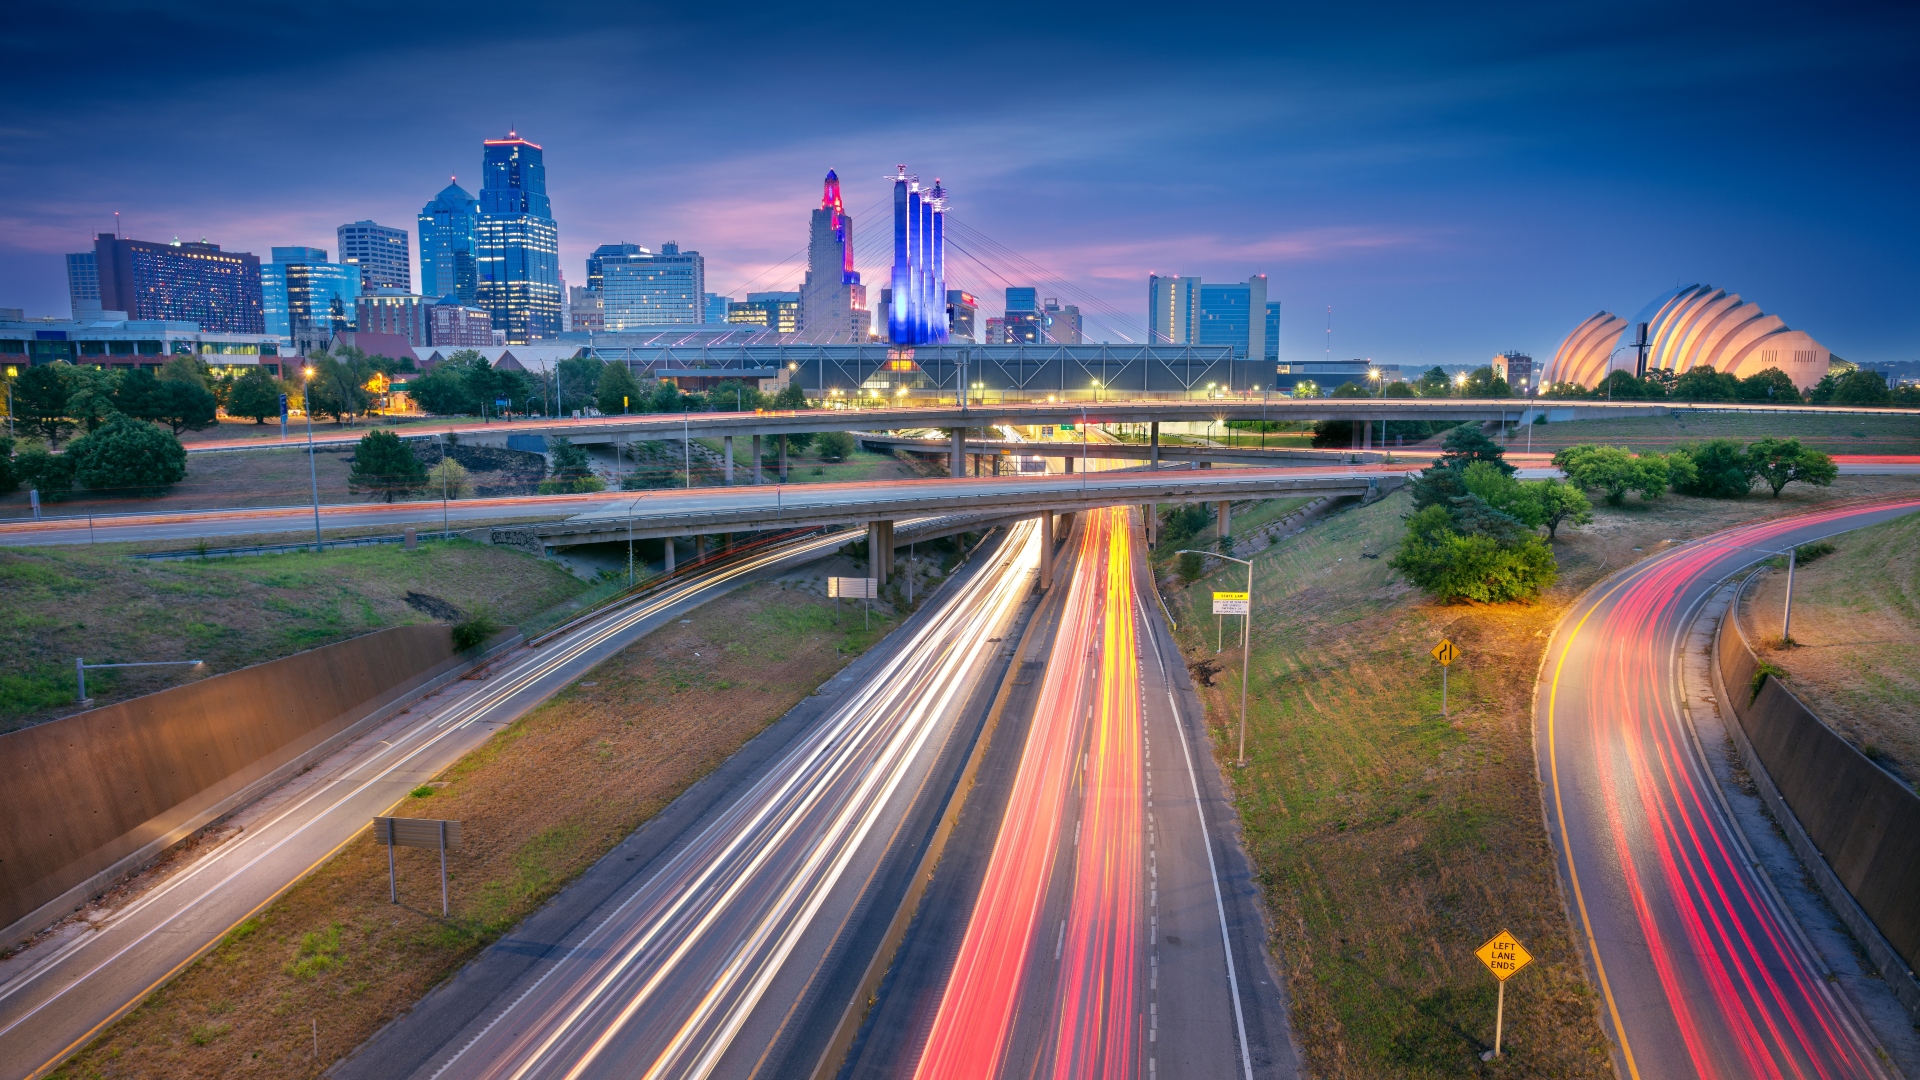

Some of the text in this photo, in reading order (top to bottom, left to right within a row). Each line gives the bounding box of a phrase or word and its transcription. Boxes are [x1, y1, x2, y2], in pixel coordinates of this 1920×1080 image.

[1494, 942, 1515, 950] LEFT
[1492, 952, 1516, 960] LANE
[1490, 960, 1516, 970] ENDS
